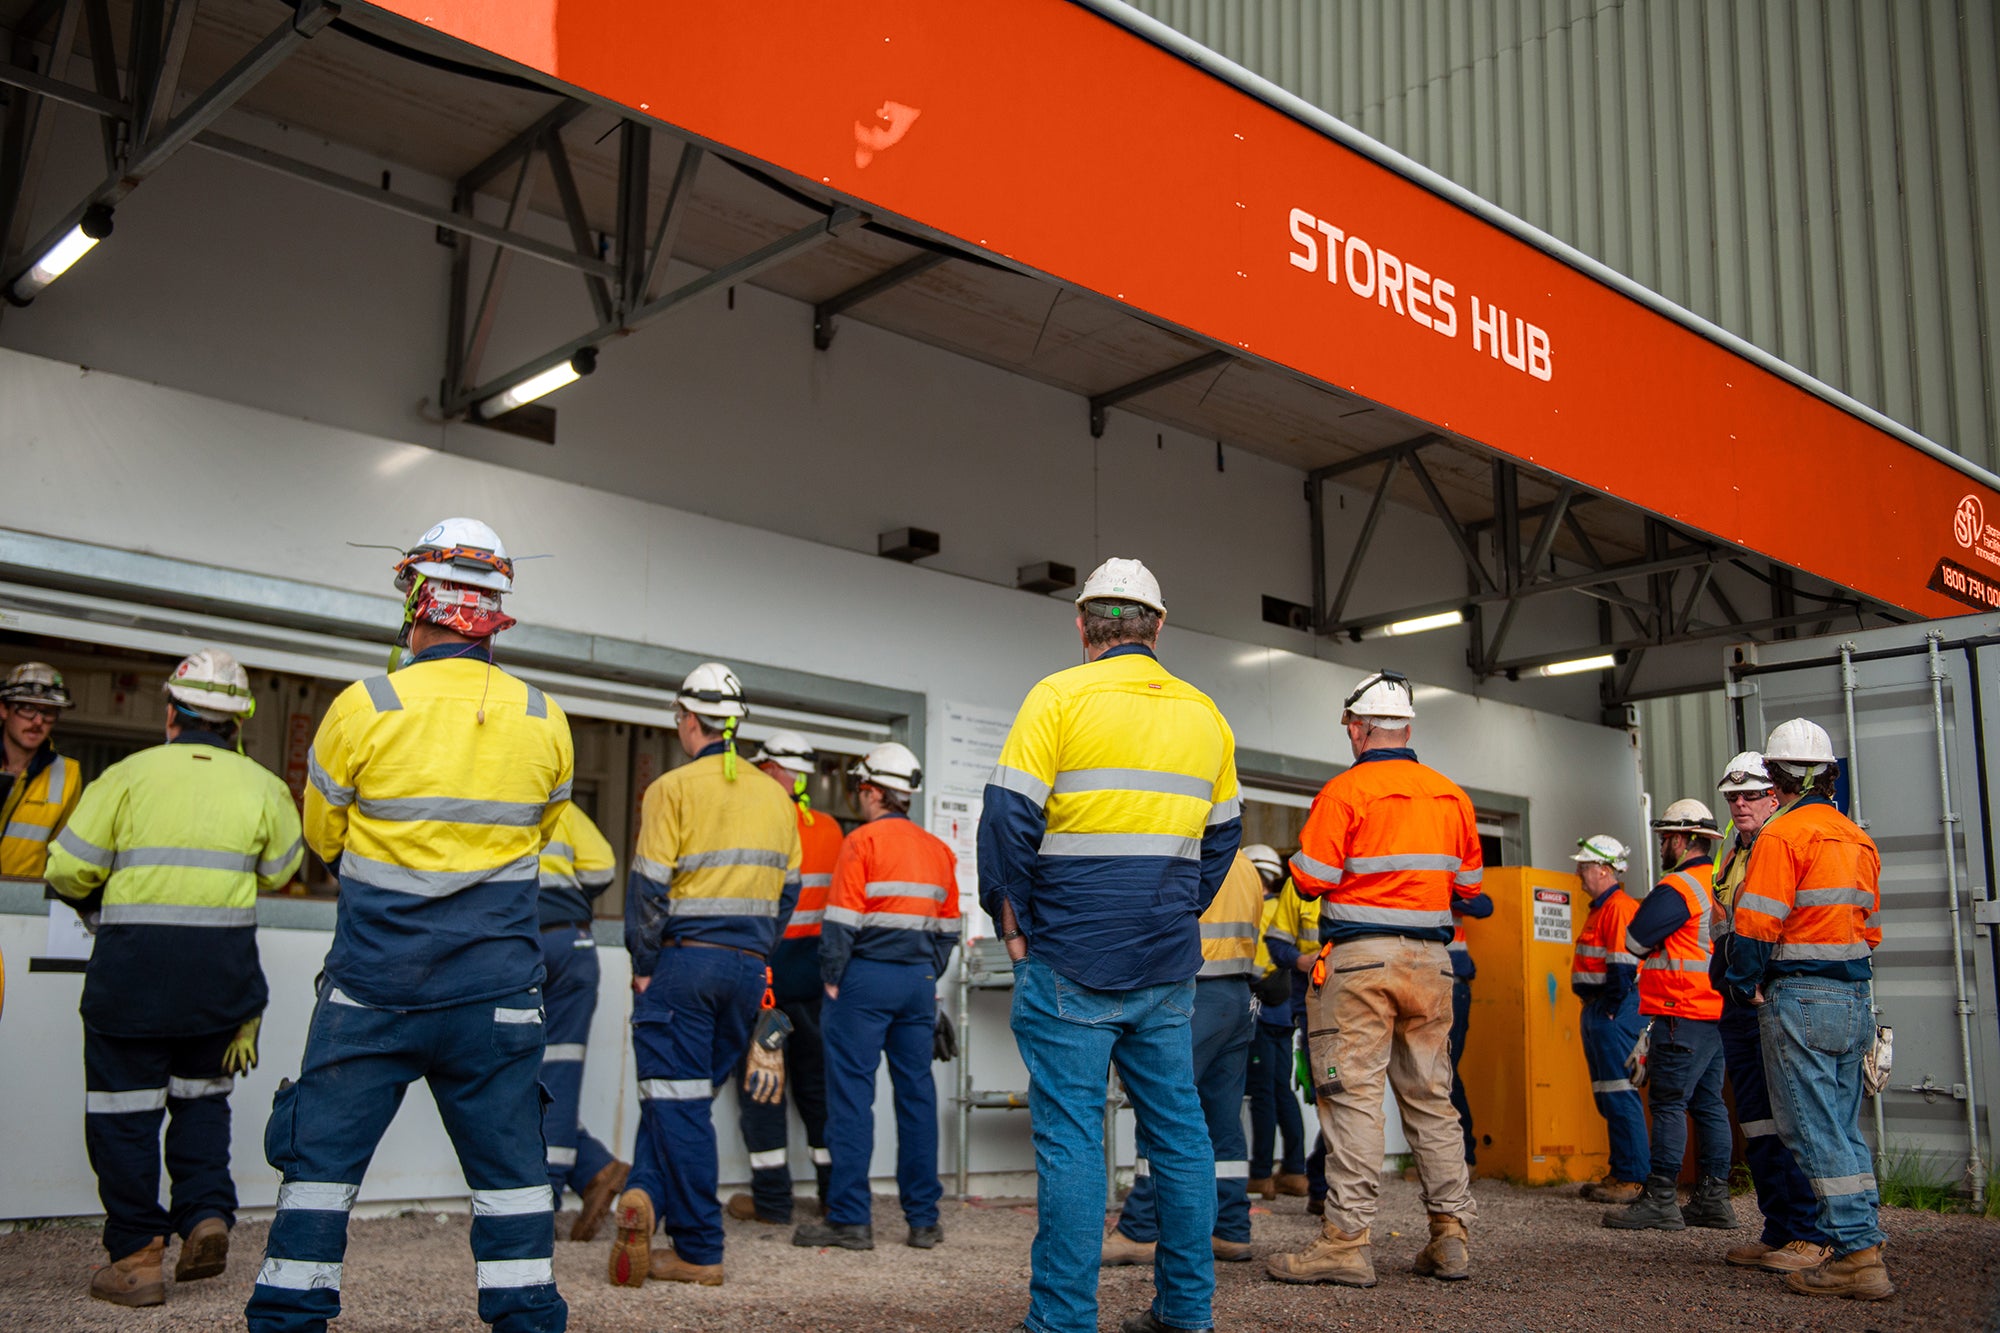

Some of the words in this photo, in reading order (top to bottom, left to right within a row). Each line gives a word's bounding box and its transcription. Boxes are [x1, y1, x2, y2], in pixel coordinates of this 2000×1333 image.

[1289, 208, 1457, 338] STORES
[1471, 295, 1552, 382] HUB
[1942, 565, 1965, 593] 1800
[1966, 576, 1985, 602] 734
[1541, 891, 1562, 902] DANGER
